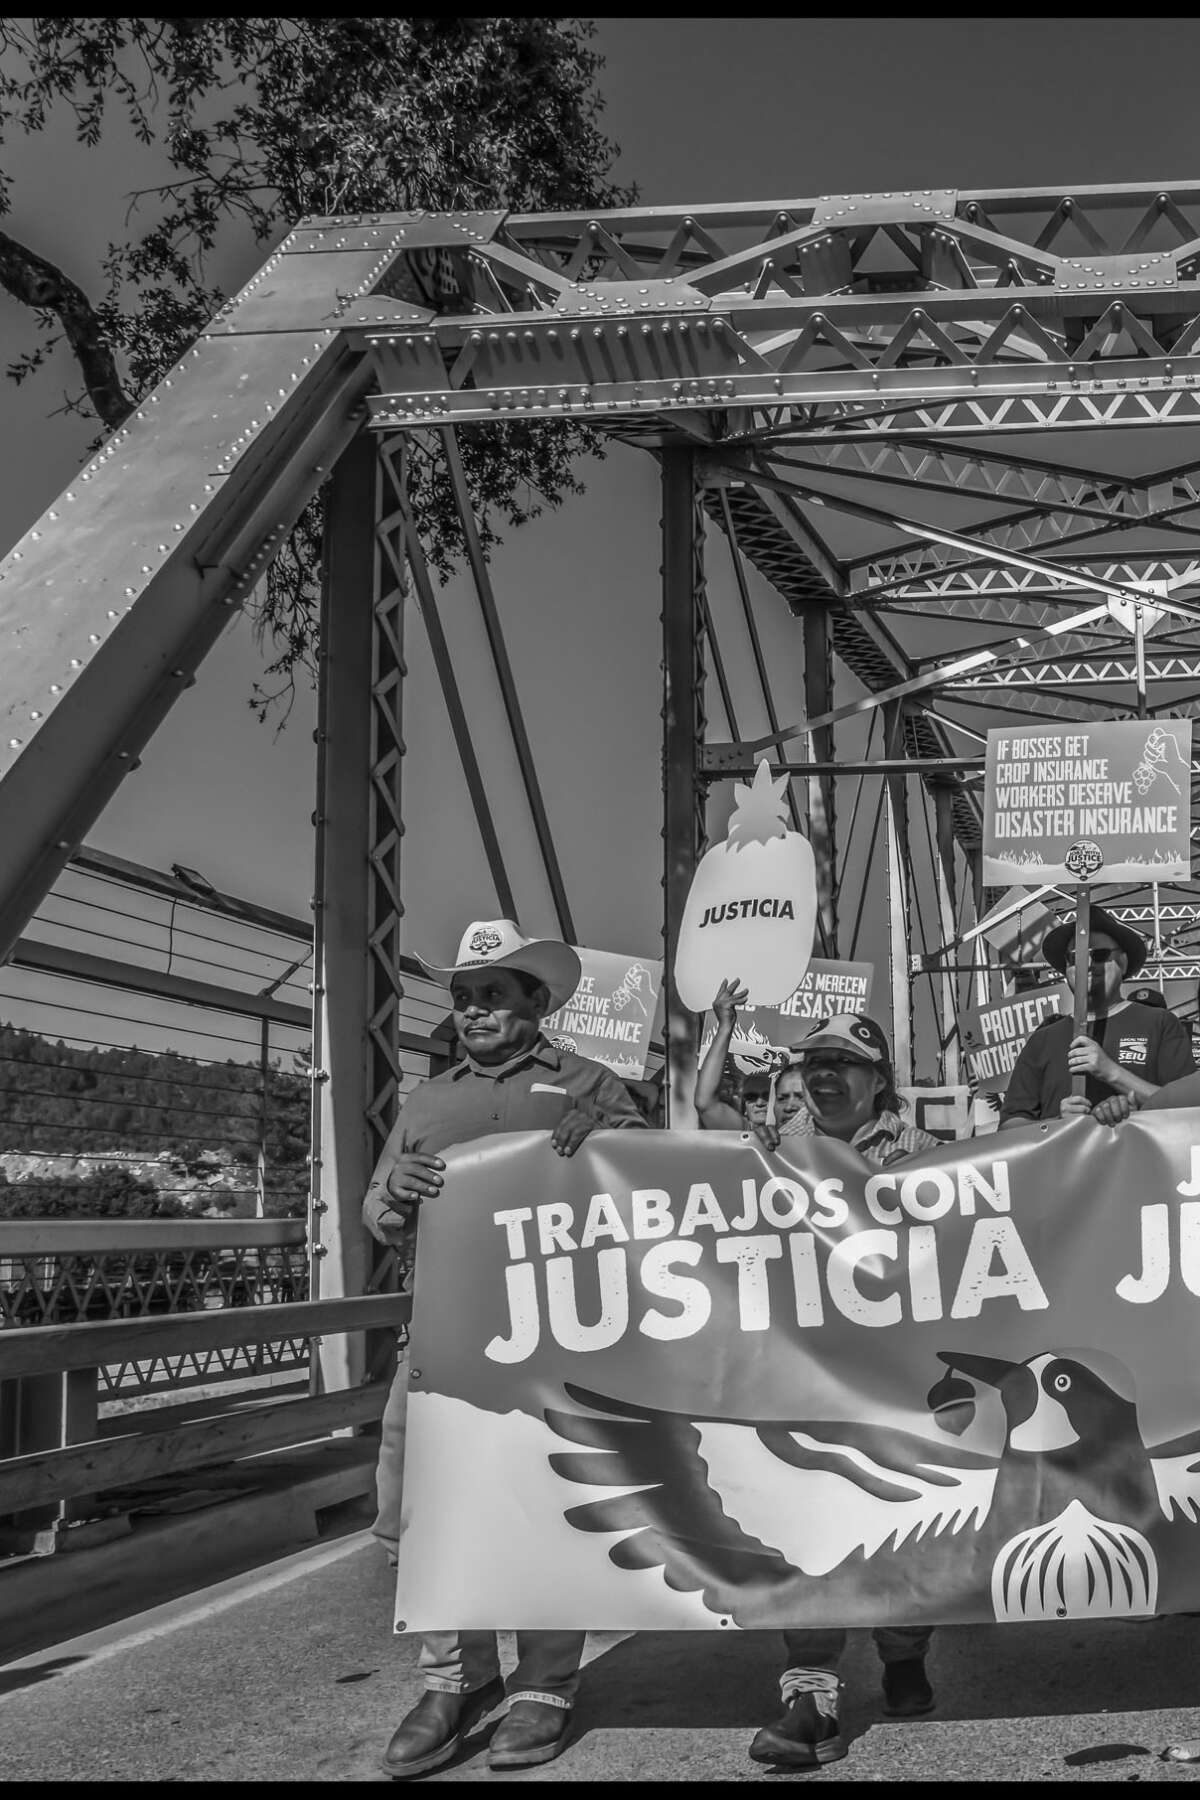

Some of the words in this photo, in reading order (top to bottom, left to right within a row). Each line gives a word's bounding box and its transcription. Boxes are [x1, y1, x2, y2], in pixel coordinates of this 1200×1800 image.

[996, 740, 1010, 760] IF
[1012, 737, 1062, 760] BOSSES
[1065, 735, 1090, 757] GET
[996, 762, 1031, 784] CROP
[1033, 759, 1109, 782] INSURANCE
[995, 783, 1065, 809] WORKERS
[1068, 781, 1133, 806] DESERVE
[994, 808, 1075, 838] DISASTER
[1079, 806, 1178, 836] INSURANCE
[1066, 854, 1102, 863] JUSTICE
[699, 898, 796, 929] JUSTICIA
[815, 974, 868, 996] MERECEN
[565, 992, 611, 1015] ESERVE
[779, 990, 866, 1019] DESASTRE
[562, 1010, 643, 1044] INSURANCE
[979, 993, 1062, 1046] PROTECT
[1118, 1052, 1147, 1061] SEIU
[493, 1177, 850, 1260] TRABAJOS
[864, 1160, 1012, 1226] CON
[484, 1215, 1050, 1364] JUSTICIA
